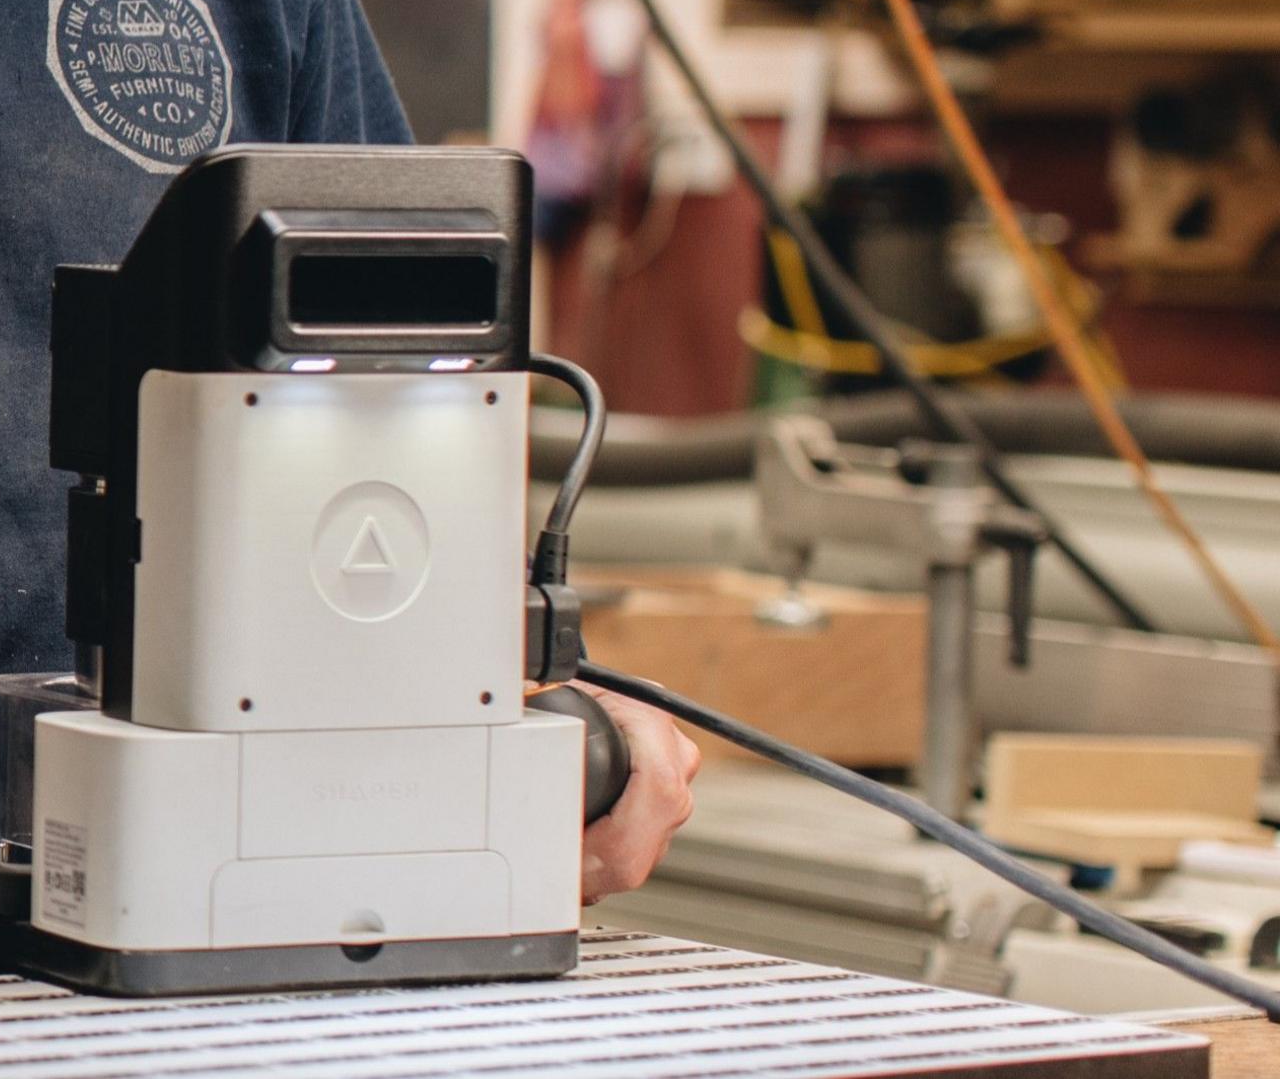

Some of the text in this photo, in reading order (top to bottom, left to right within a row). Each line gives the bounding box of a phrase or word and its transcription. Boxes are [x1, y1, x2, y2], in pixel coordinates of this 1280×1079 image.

[65, 3, 89, 39] FINE
[92, 23, 118, 36] EST.
[98, 42, 205, 77] MORLEY
[110, 77, 205, 105] FURNITURE
[68, 59, 176, 157] SEMI-AUTHENTIC
[153, 101, 187, 124] CO.
